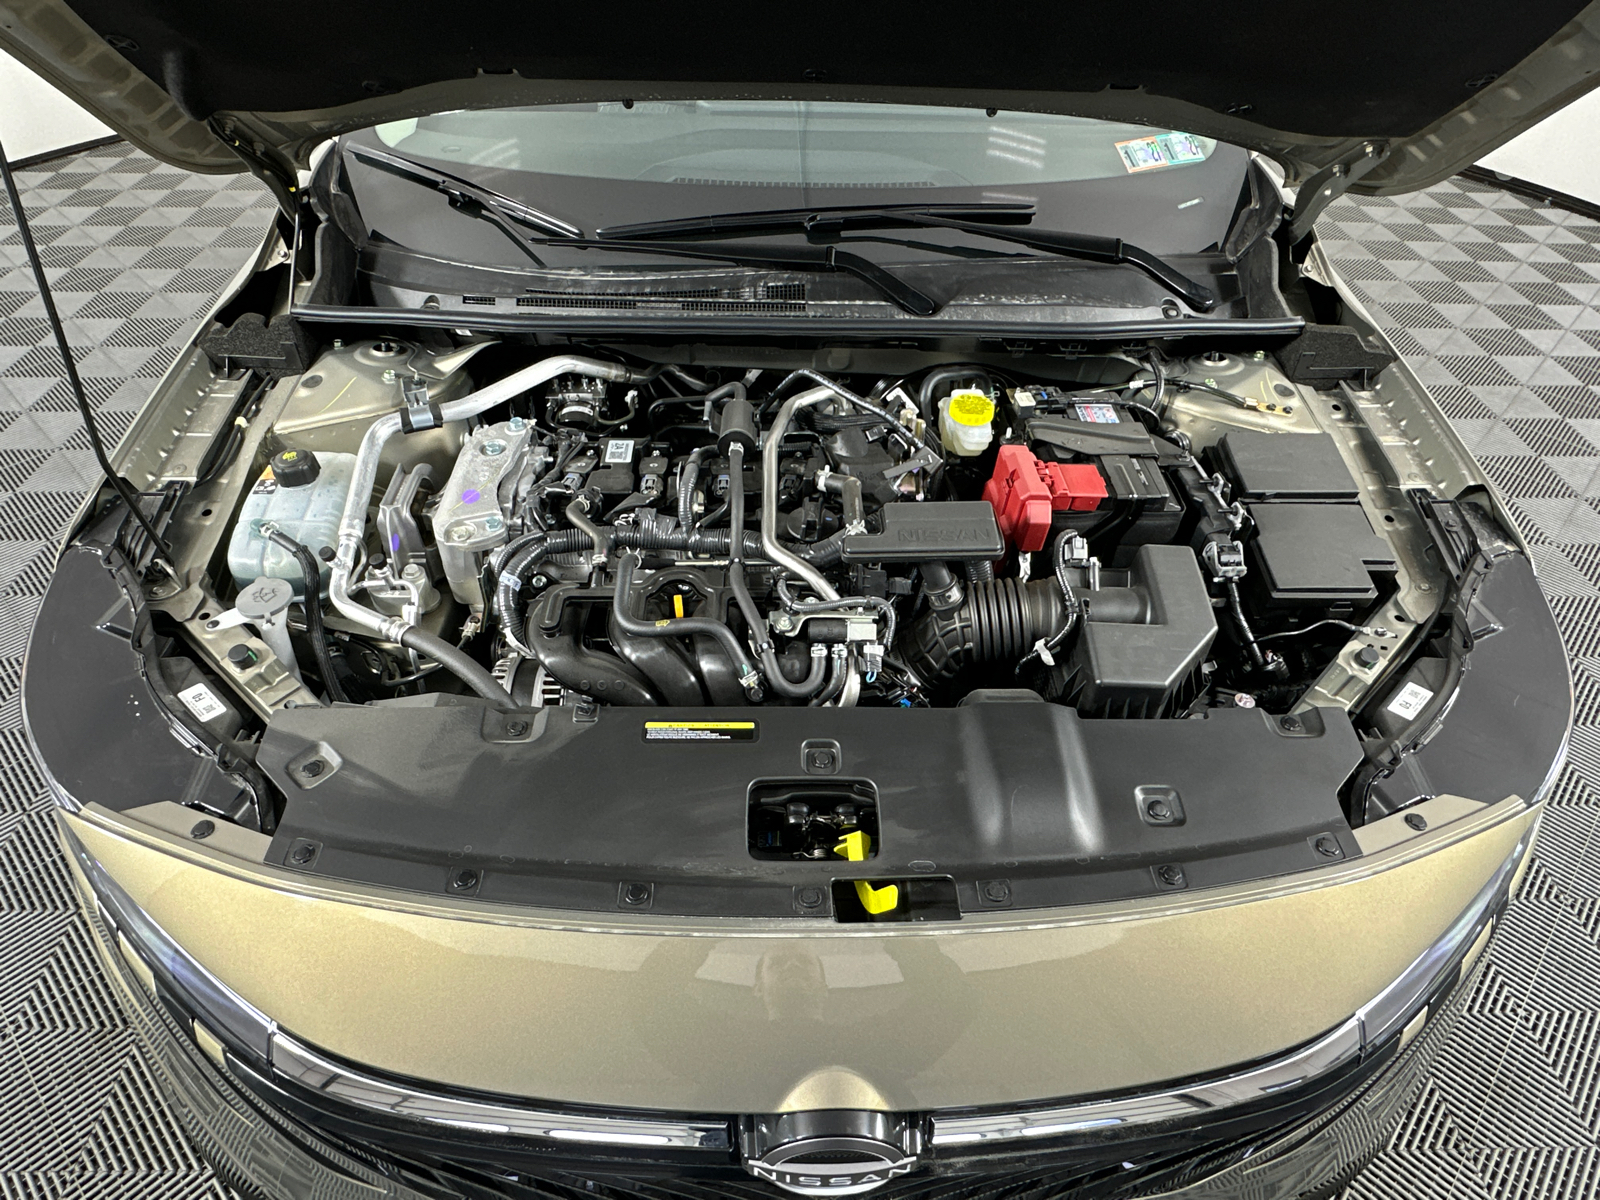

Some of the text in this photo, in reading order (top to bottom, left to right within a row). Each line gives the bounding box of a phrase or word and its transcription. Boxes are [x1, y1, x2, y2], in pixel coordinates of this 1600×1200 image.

[1123, 150, 1136, 168] 1
[1163, 142, 1176, 161] 1
[897, 528, 991, 542] NISSAN
[753, 1163, 911, 1187] NISSAN
